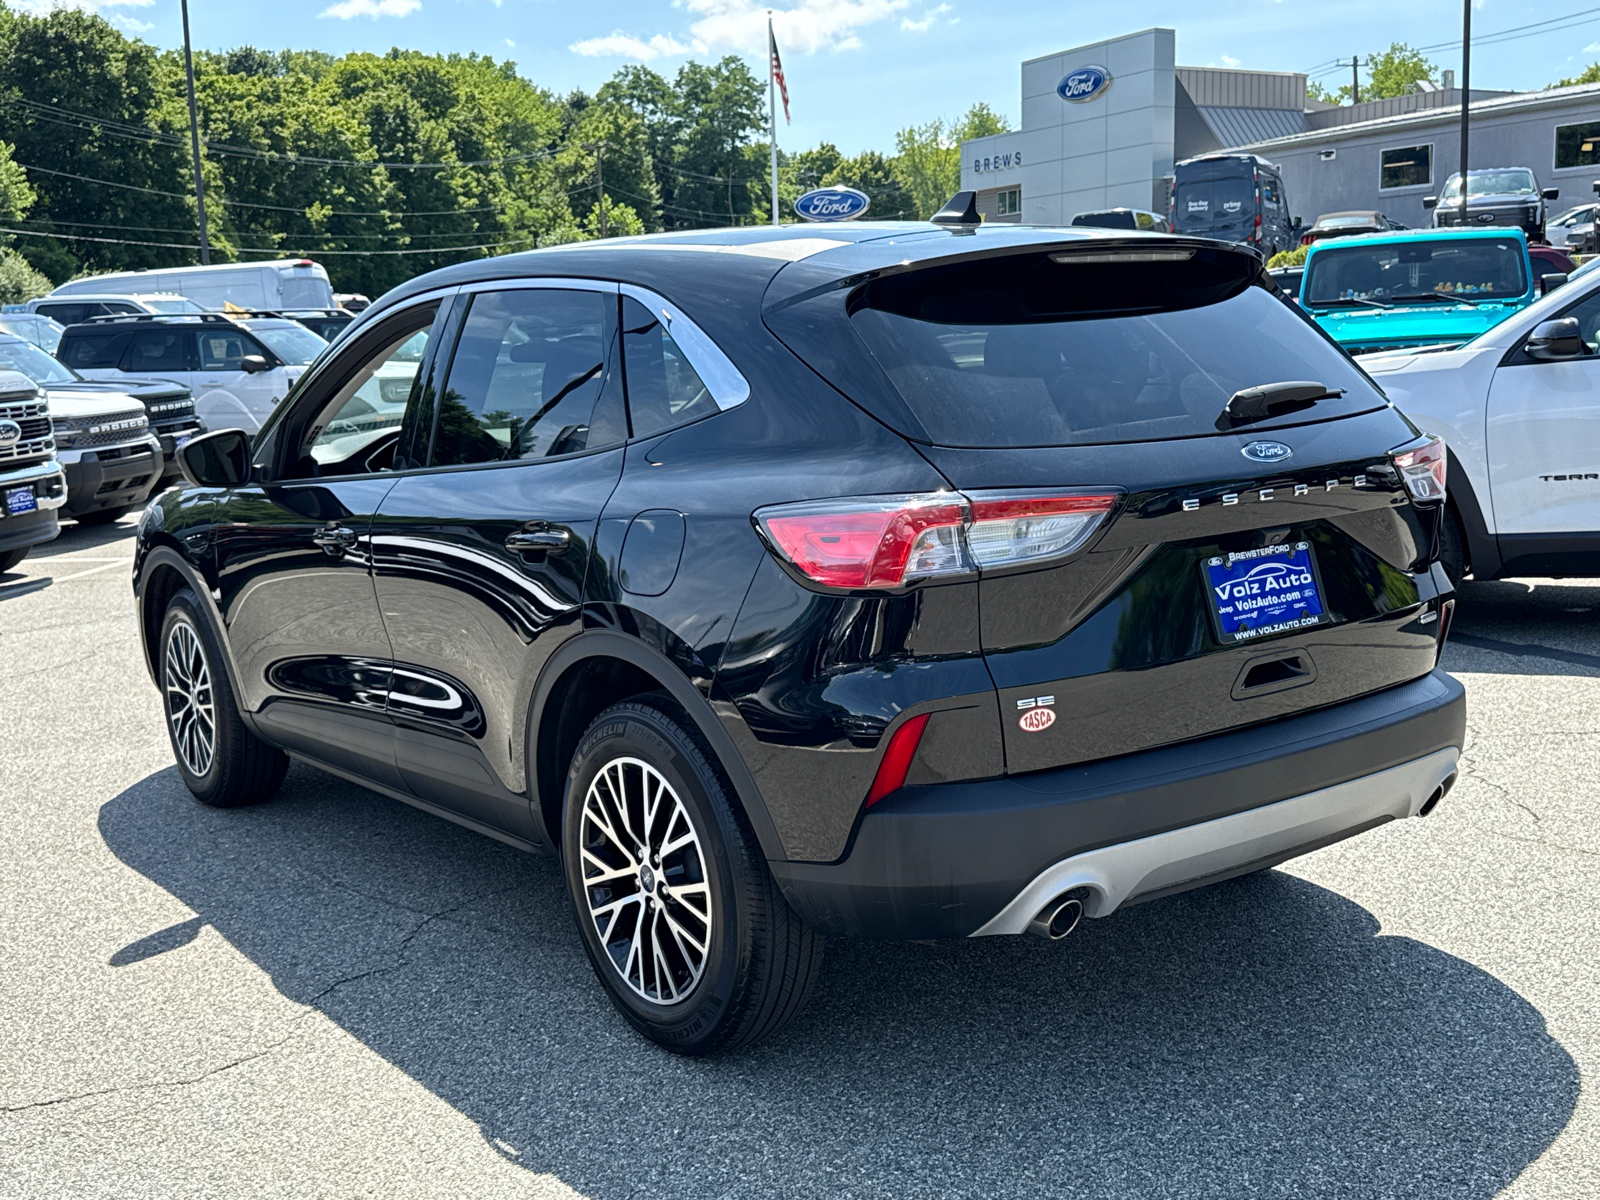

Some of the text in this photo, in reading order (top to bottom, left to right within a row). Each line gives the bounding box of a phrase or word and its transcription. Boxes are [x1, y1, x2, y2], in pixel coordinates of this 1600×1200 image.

[1065, 74, 1094, 97] Ford
[974, 151, 1022, 173] BREWS
[809, 195, 853, 215] Ford
[1223, 201, 1241, 210] prime
[151, 401, 193, 413] BRONCO
[89, 420, 144, 434] BRONCO
[1255, 443, 1284, 457] Ford
[1538, 473, 1600, 482] TERR
[1182, 474, 1367, 512] ESCAPE
[1214, 572, 1312, 601] Volz Auto
[1218, 606, 1234, 614] Jeep
[1235, 591, 1301, 612] VolzAuto.com
[1234, 616, 1319, 640] WWW.VOLZAUTO.COM
[1016, 695, 1055, 710] SE
[1024, 710, 1052, 728] TASCA
[582, 723, 626, 755] MICHELIN
[631, 725, 657, 742] 225/60
